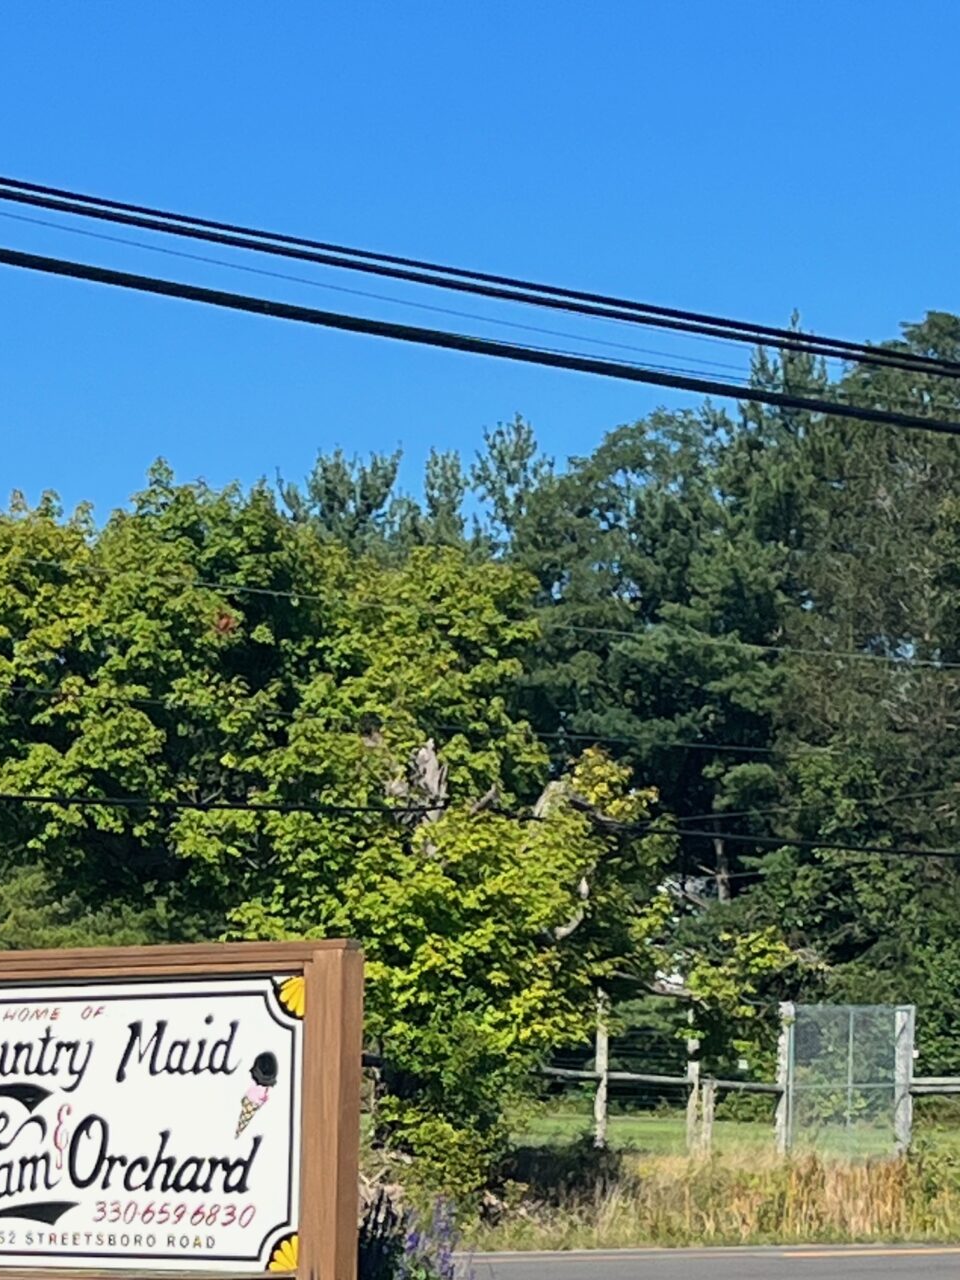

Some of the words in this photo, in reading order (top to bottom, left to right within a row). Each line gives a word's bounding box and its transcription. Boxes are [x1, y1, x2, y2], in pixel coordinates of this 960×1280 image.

[2, 1007, 61, 1022] HOME
[81, 1006, 105, 1020] OF
[115, 1013, 242, 1083] Maid
[68, 1113, 264, 1194] Orchard
[25, 1231, 157, 1248] STREETSBORO
[166, 1234, 216, 1249] ROAD
